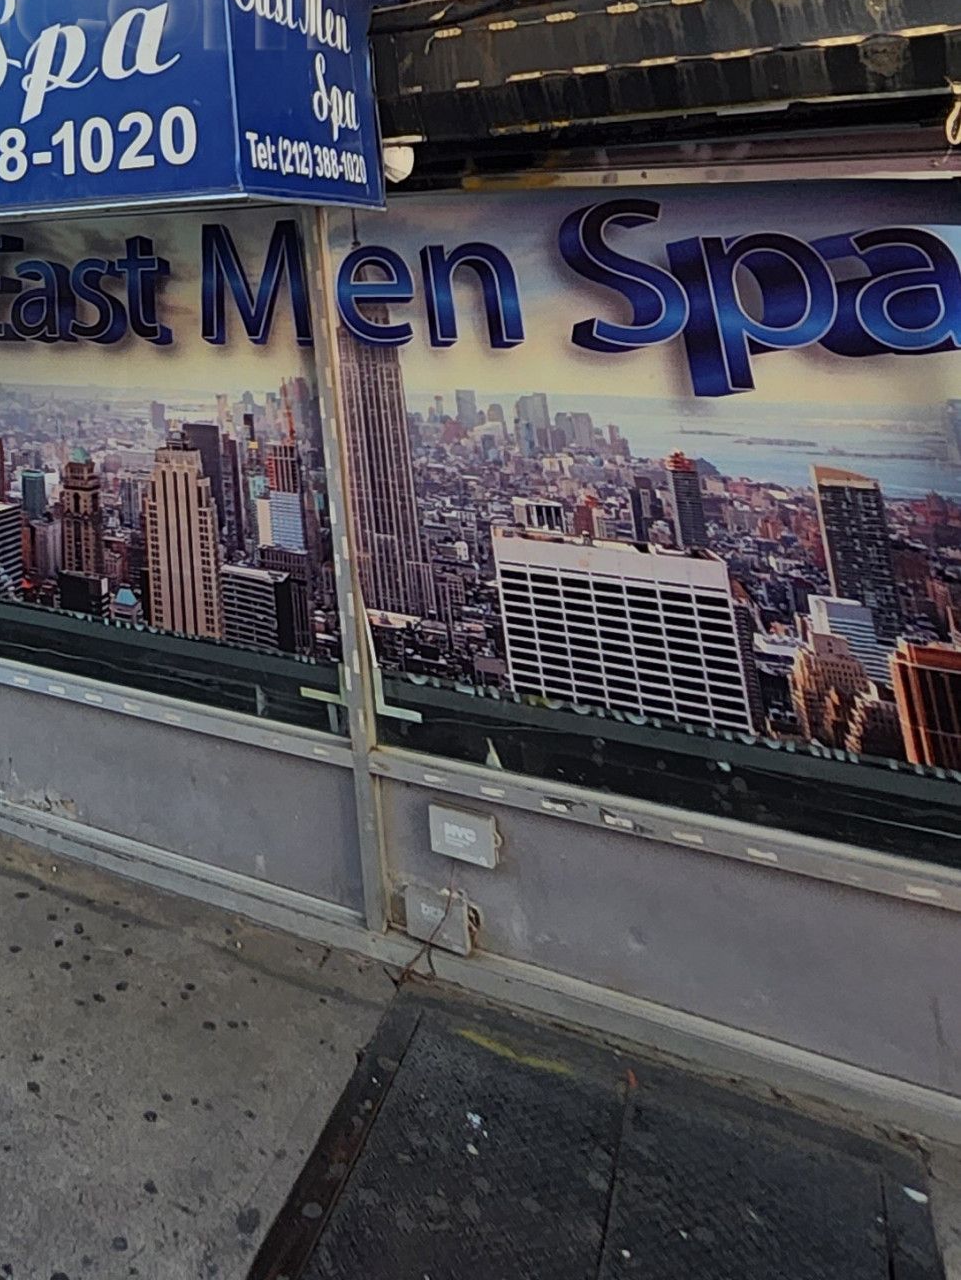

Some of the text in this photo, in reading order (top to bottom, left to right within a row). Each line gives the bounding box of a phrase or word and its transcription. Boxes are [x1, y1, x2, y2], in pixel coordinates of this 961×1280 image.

[313, 52, 360, 142] Spa
[246, 132, 367, 185] Tel: (212) 388-1020
[201, 219, 525, 348] Men
[559, 198, 961, 397] Spa
